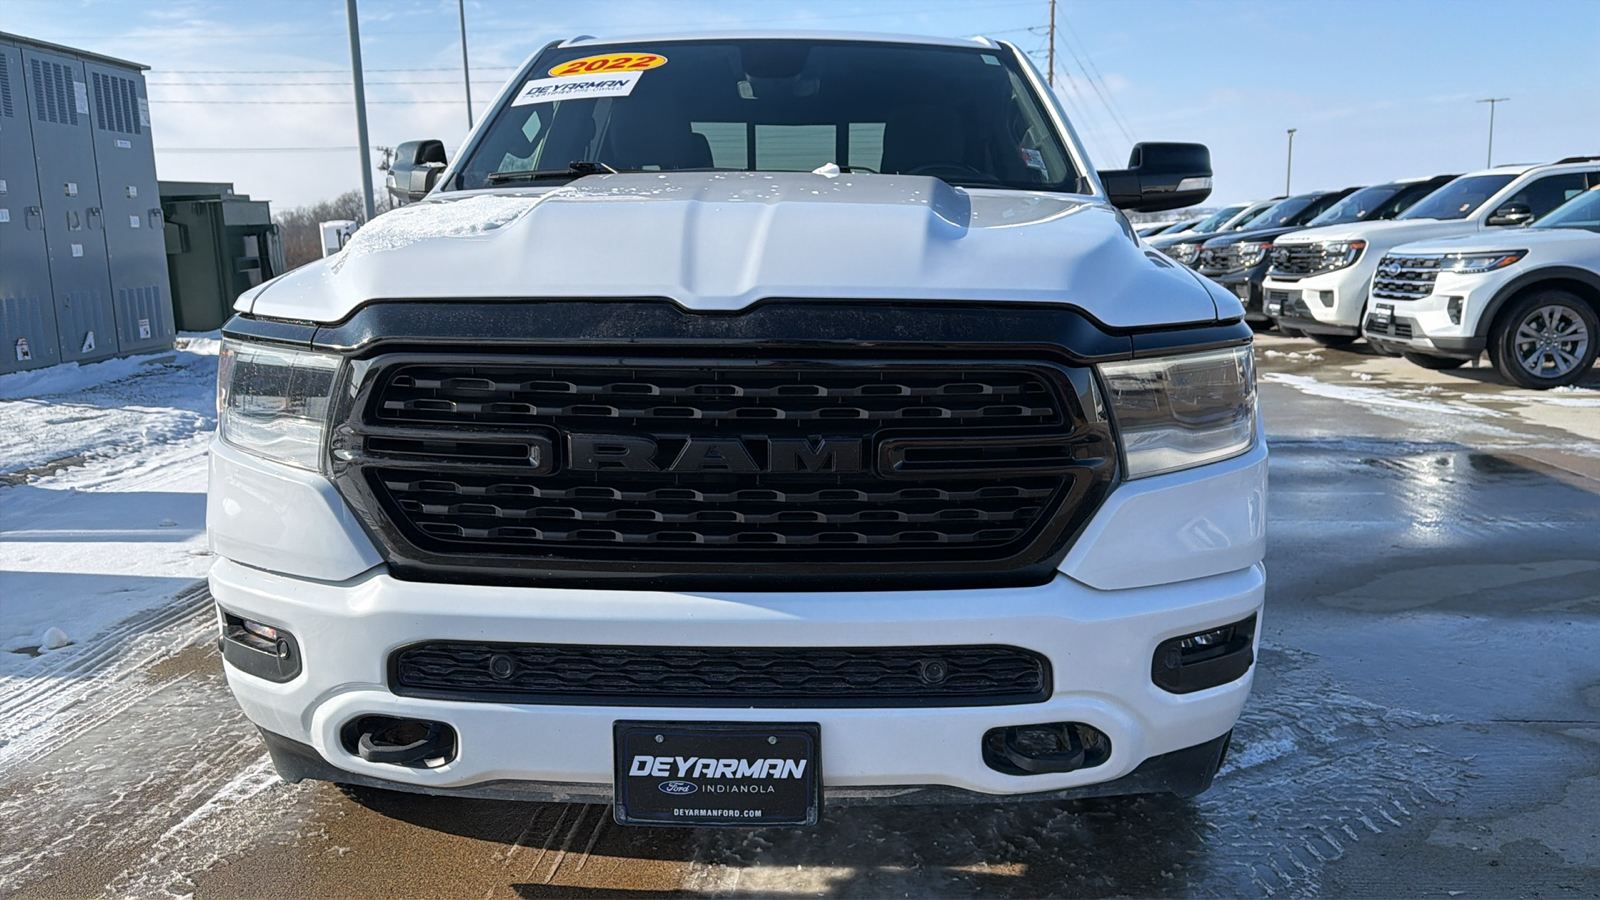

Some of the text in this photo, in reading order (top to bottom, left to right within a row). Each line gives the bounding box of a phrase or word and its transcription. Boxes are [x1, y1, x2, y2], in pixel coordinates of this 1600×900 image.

[558, 55, 657, 75] 2022
[525, 79, 631, 96] DEYARMAN
[530, 86, 623, 98] CERTIFIED PRE-OWNED
[567, 433, 863, 472] RAM
[628, 755, 807, 779] DEYARMAN
[666, 782, 775, 793] Ford INDIANOLA
[673, 808, 762, 818] DEYARMANFORD.COM
